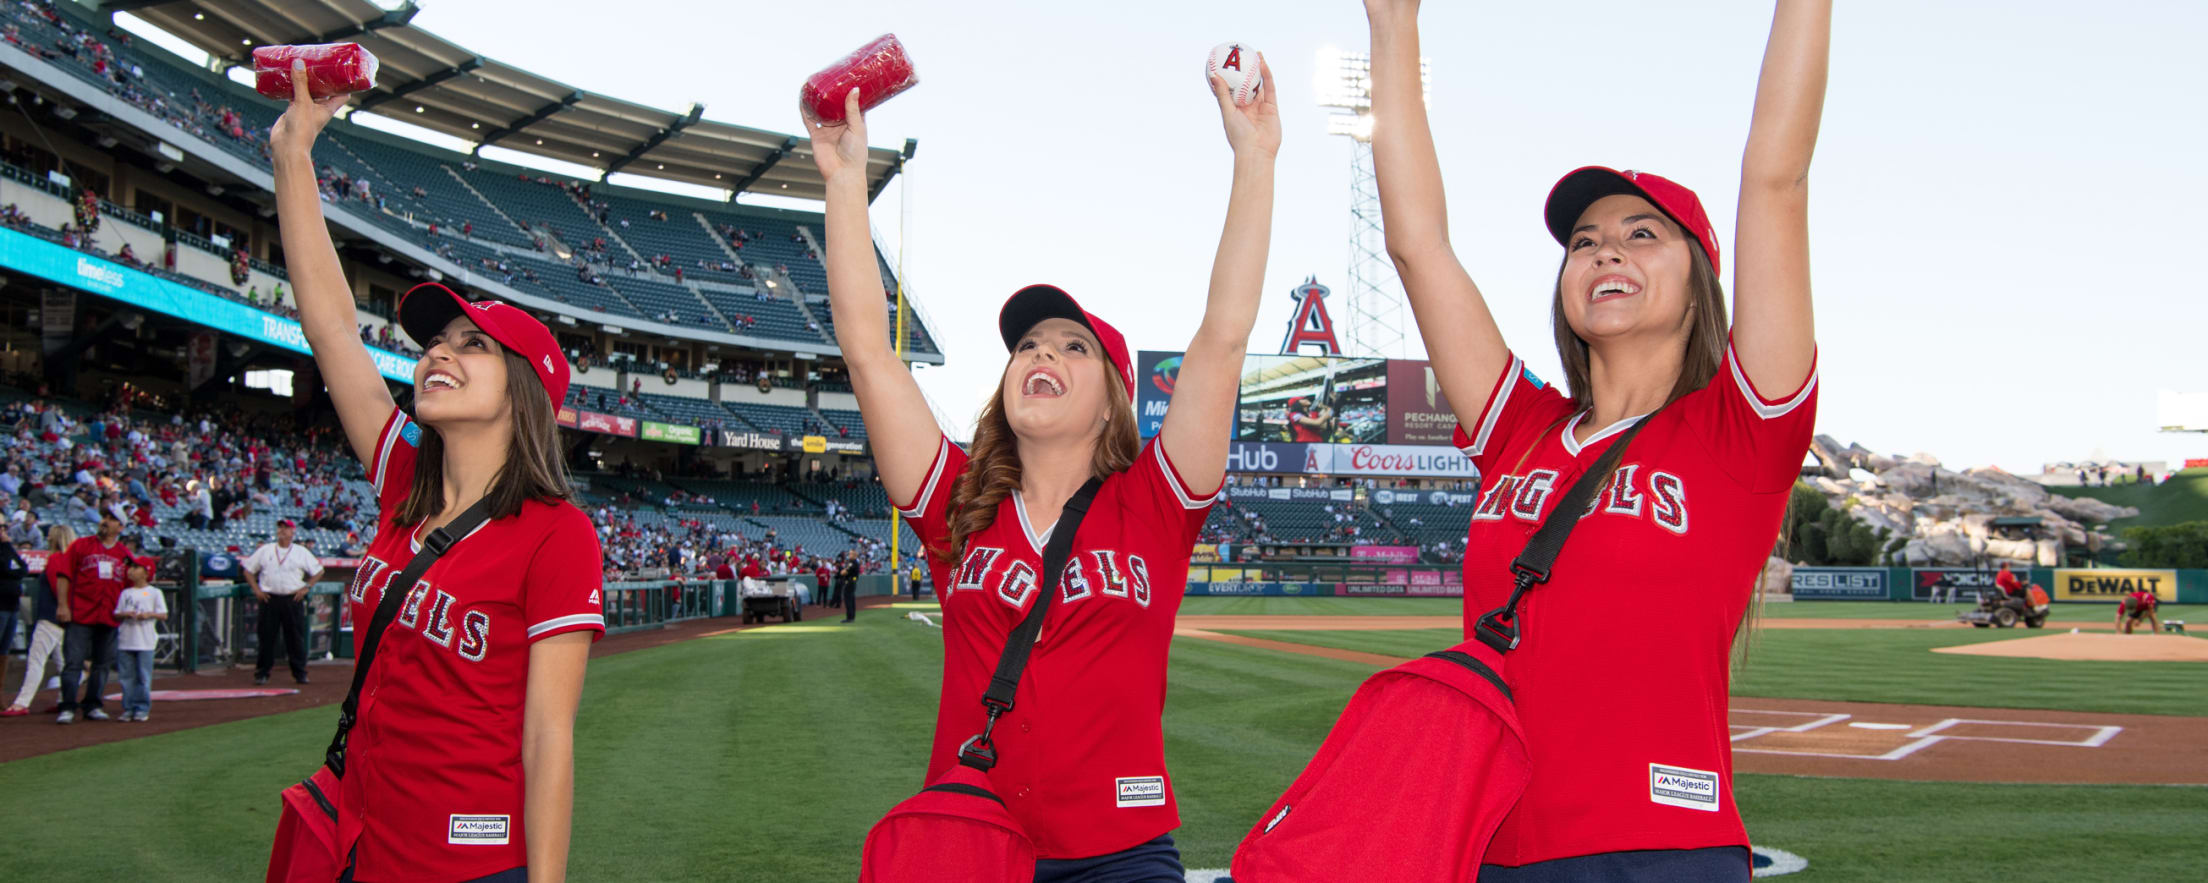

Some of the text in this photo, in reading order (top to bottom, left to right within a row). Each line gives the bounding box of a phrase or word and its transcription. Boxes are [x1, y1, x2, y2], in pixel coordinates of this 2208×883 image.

[1222, 44, 1243, 72] A
[1282, 273, 1343, 357] A
[1404, 412, 1458, 423] PECHANG
[724, 431, 780, 450] Yard House
[826, 440, 863, 451] generation
[1226, 444, 1278, 471] Hub
[1351, 445, 1470, 471] Coors LIGHT
[1230, 487, 1267, 497] StubHub
[1292, 488, 1328, 498] StubHub
[946, 547, 1151, 608] NGELS
[1792, 574, 1830, 587] RES
[1347, 585, 1404, 593] UNLIMITED DATA
[1407, 585, 1446, 594] UNLIMITED
[1133, 784, 1159, 793] Majestic
[1672, 777, 1710, 791] Majestic
[470, 823, 503, 831] Majestic
